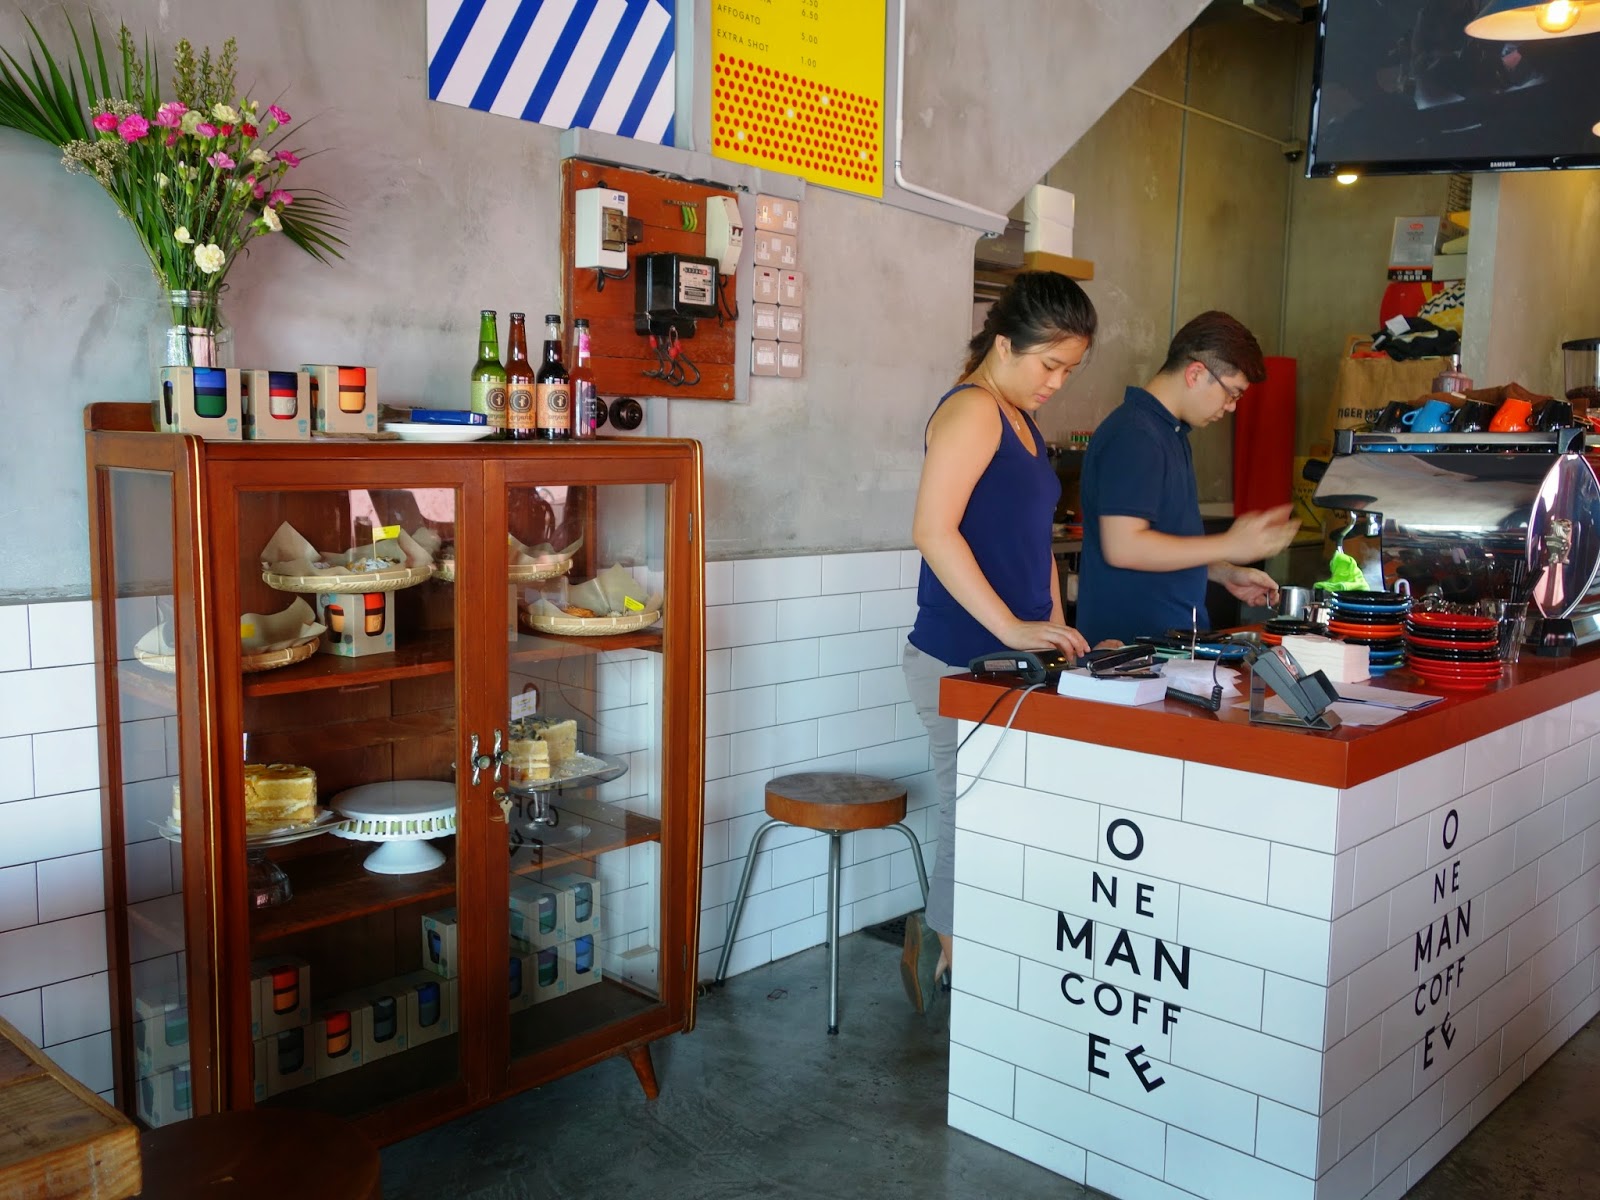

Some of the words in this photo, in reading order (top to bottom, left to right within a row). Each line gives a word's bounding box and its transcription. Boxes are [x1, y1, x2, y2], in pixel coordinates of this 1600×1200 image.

[717, 4, 760, 25] AFFOGATO
[801, 9, 819, 21] 6.50
[717, 28, 744, 45] EXTRA
[747, 38, 769, 52] SHOT
[801, 32, 818, 45] 5.00
[801, 56, 817, 68] 1.00
[1106, 818, 1144, 861] O
[1442, 809, 1459, 850] O
[1056, 910, 1191, 990] MAN
[1414, 899, 1471, 972] MAN
[1060, 972, 1181, 1035] COFF
[1414, 956, 1466, 1016] COFF
